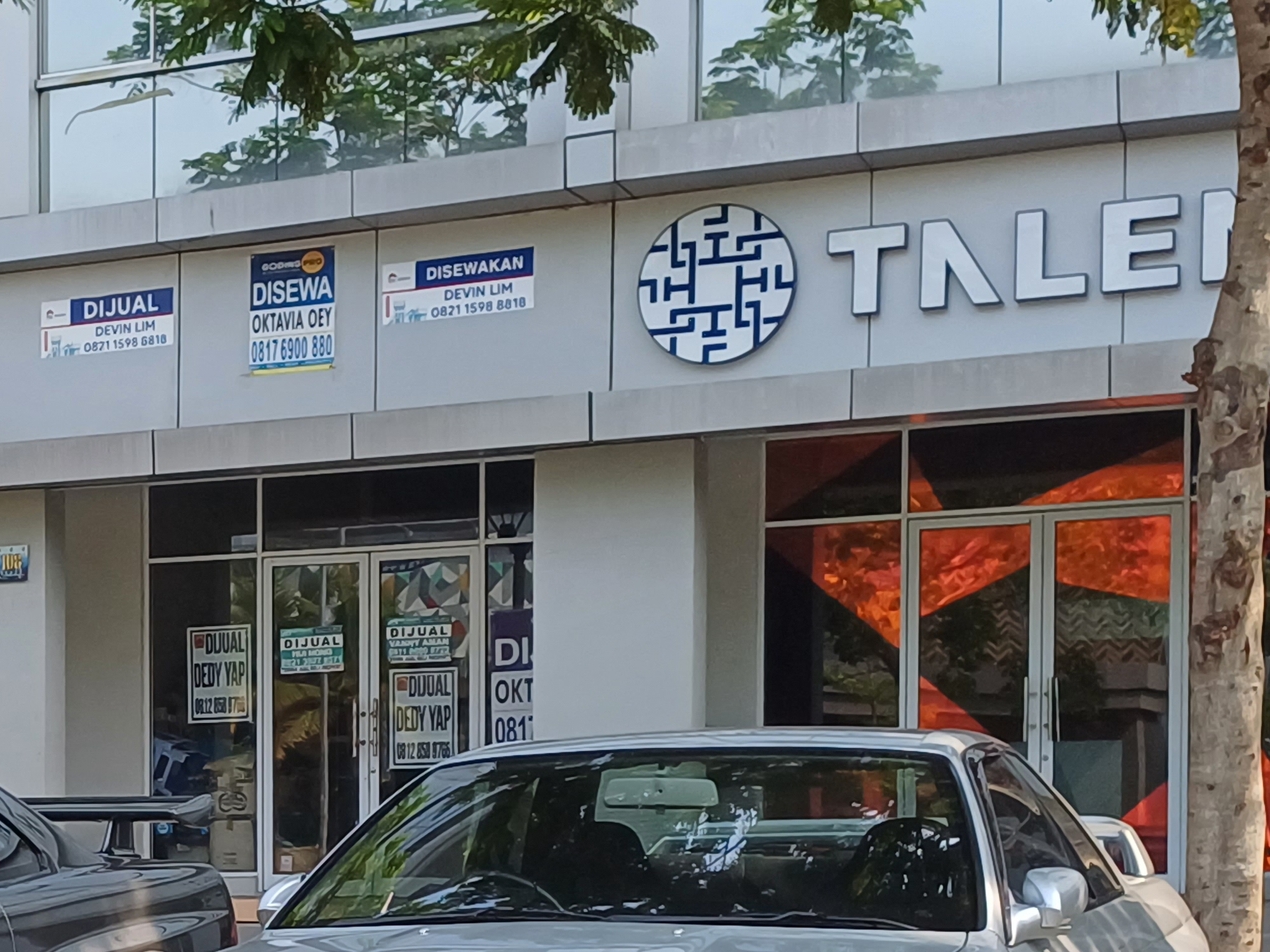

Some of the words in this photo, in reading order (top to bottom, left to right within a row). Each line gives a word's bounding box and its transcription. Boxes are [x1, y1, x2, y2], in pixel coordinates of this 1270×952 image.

[426, 255, 523, 281] DISEWAKAN
[252, 275, 333, 306] DISEWA
[444, 285, 485, 301] DEVIN
[490, 282, 513, 296] LIM
[83, 293, 159, 320] DIJUAL
[431, 304, 461, 318] 0821
[465, 301, 493, 314] 1598
[95, 322, 131, 337] DEVIN
[135, 320, 155, 333] LIM
[252, 310, 304, 334] OKTAVIA
[308, 307, 332, 328] OEY
[113, 336, 138, 350] 1598
[251, 339, 278, 363] 0817
[281, 336, 308, 360] 6900
[312, 334, 332, 357] 880
[205, 631, 245, 655] DIJUAL
[284, 636, 340, 649] DIJUAL
[391, 626, 448, 638] DIJUAL
[224, 661, 245, 687] YAP
[409, 674, 451, 697] DIJUAL
[428, 705, 451, 731] YAP
